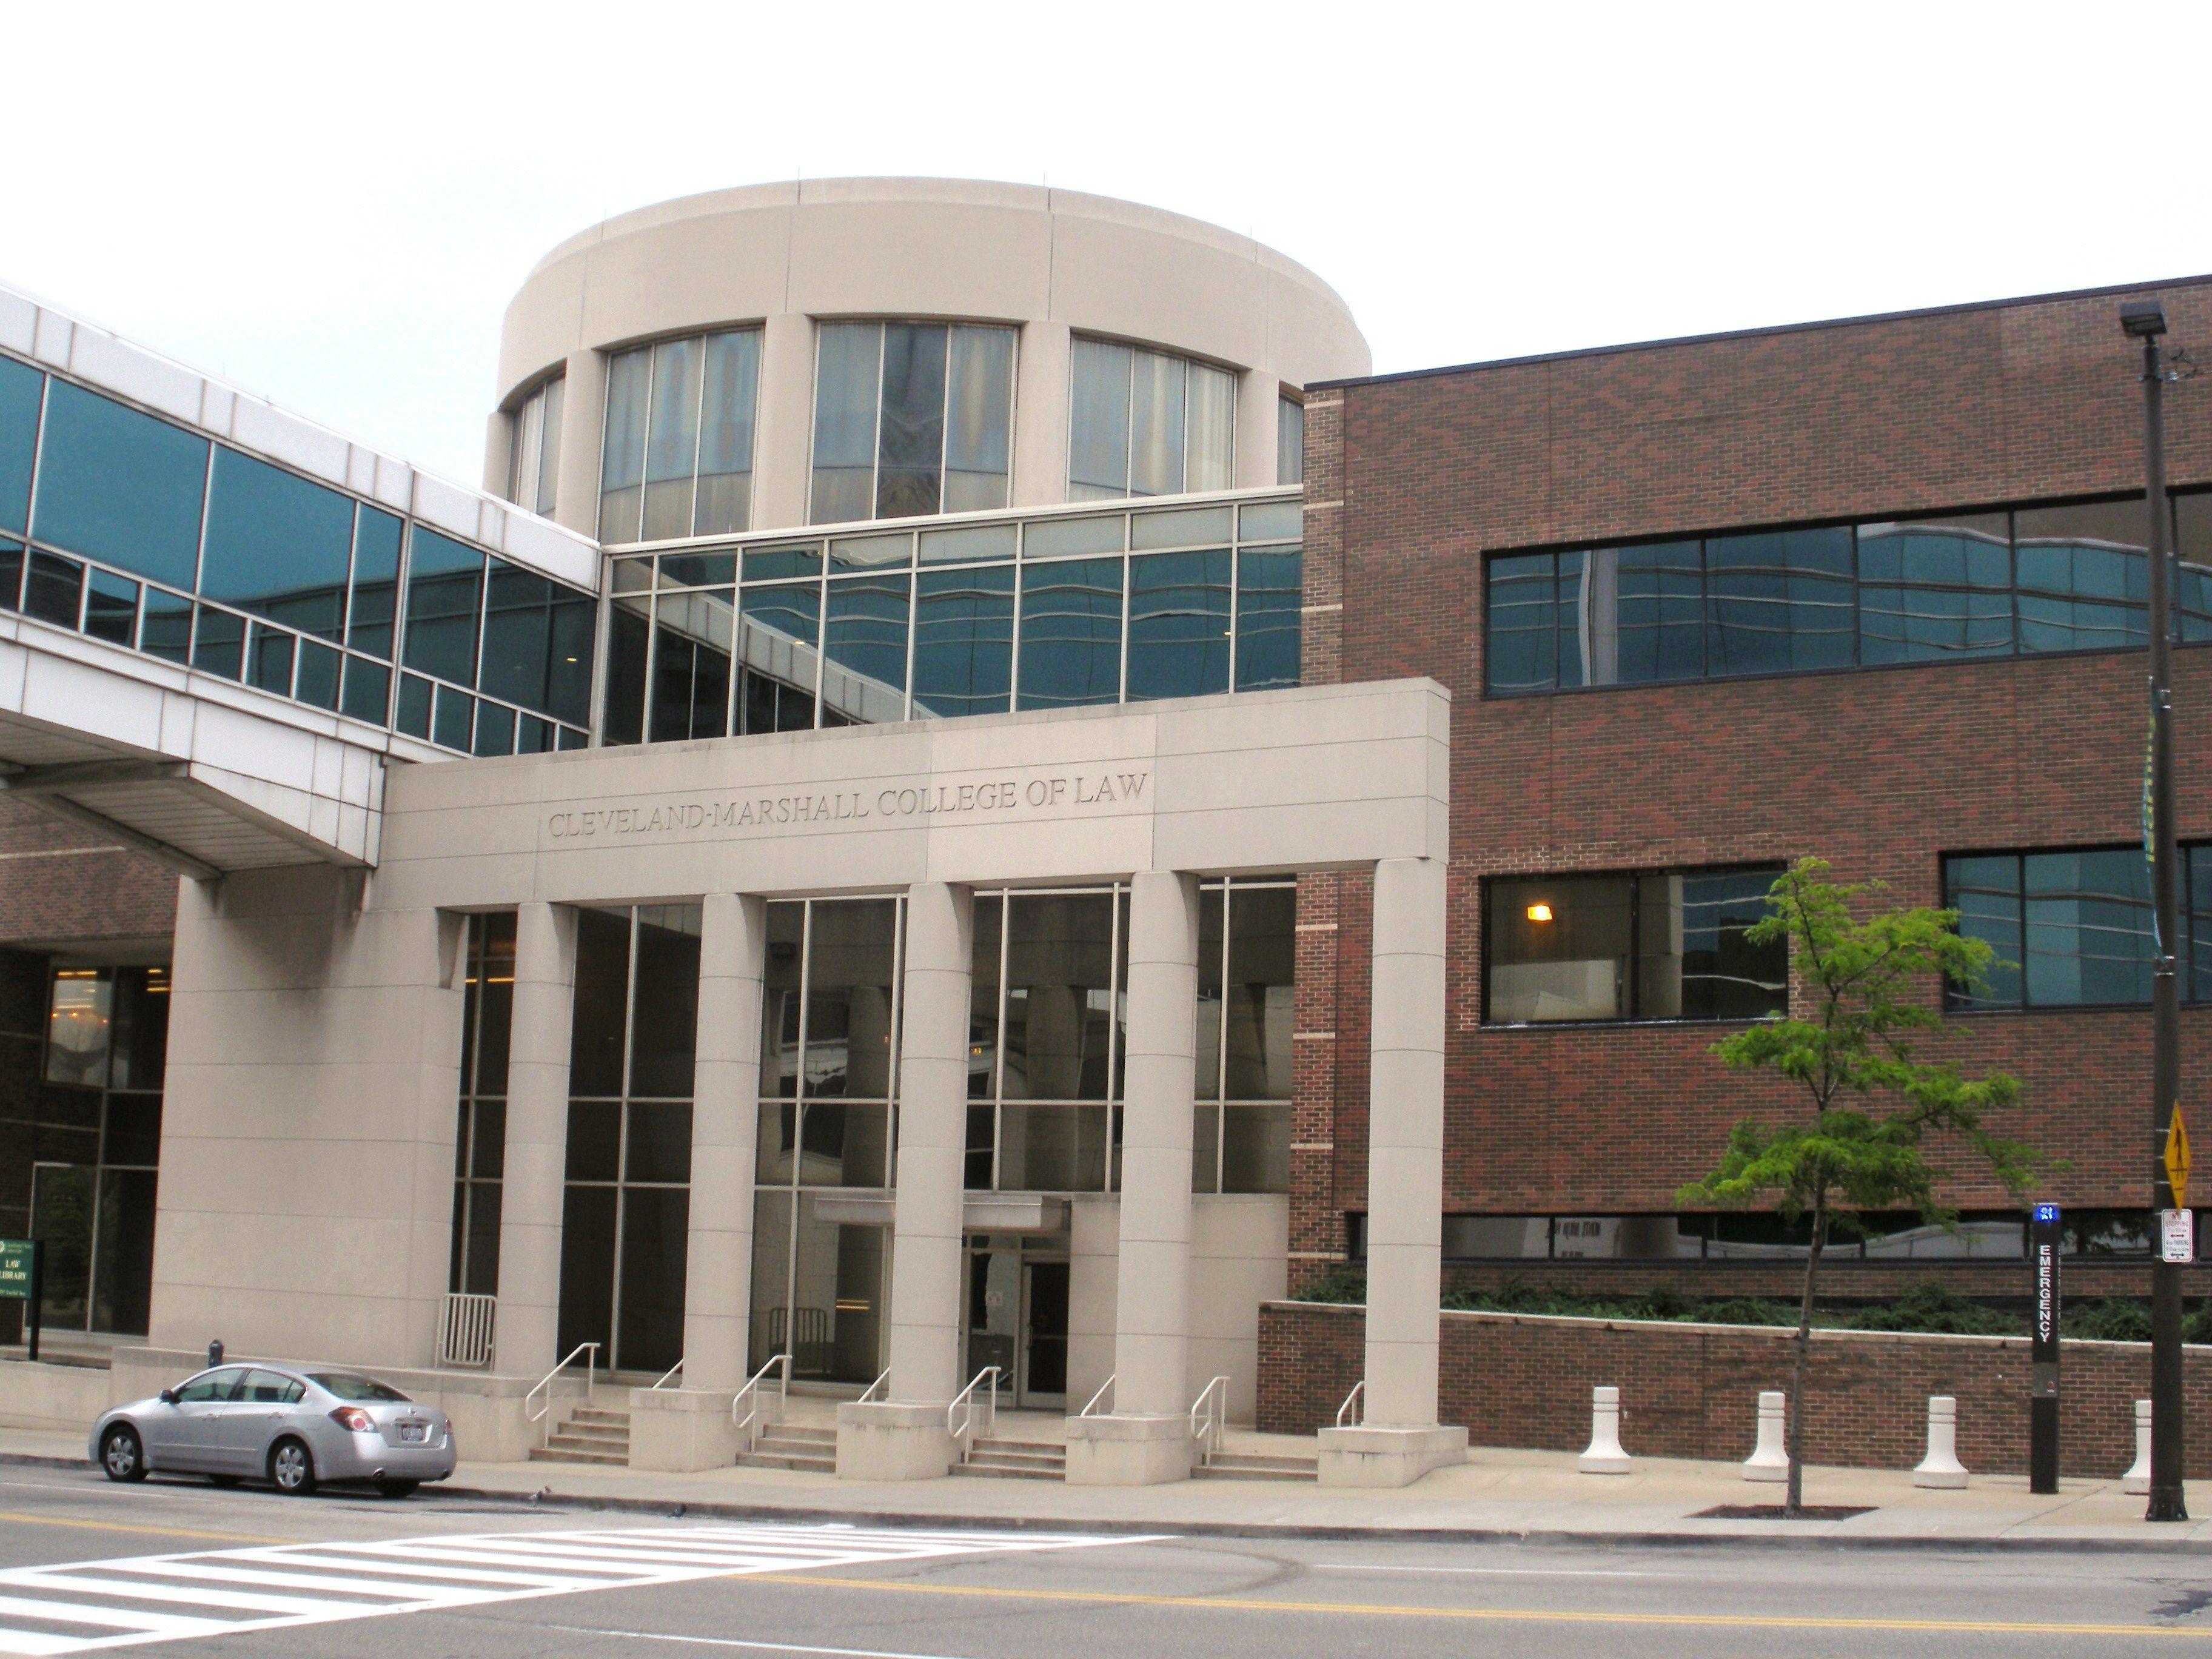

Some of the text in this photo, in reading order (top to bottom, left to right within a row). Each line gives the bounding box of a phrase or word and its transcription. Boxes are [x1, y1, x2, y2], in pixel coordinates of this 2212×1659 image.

[877, 782, 1017, 816] COLLEGE
[1026, 779, 1067, 806] OF
[1073, 773, 1147, 805] LAW
[5, 1259, 20, 1269] LAW
[2039, 1245, 2051, 1342] EMERGENCY
